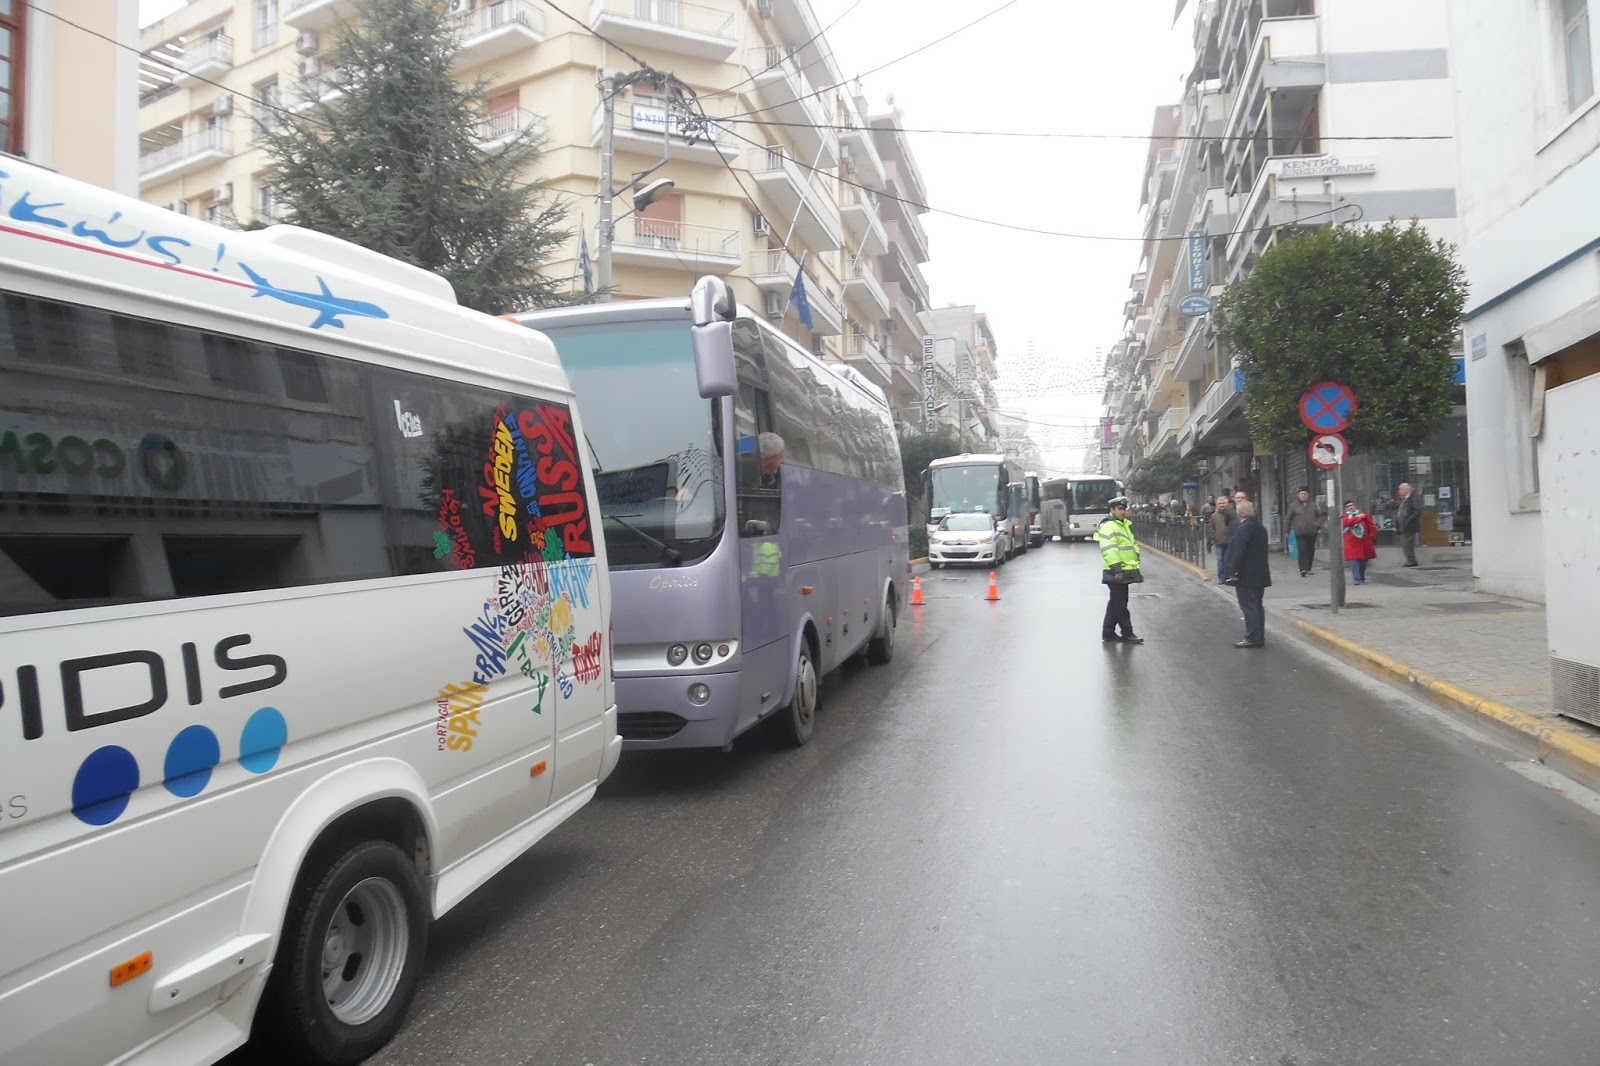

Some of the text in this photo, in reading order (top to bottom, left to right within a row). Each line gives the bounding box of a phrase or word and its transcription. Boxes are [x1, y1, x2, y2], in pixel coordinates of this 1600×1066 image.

[1282, 159, 1339, 170] ΚΕΝΤΡΟ
[494, 420, 518, 542] SWEDEN
[504, 411, 537, 498] FINLAND
[517, 404, 594, 554] RUSSIA
[498, 563, 525, 626] GERMANY
[463, 602, 507, 686] FRANCE
[505, 631, 549, 715] ITALY
[0, 633, 288, 741] IDIS
[439, 681, 489, 752] SPAIN
